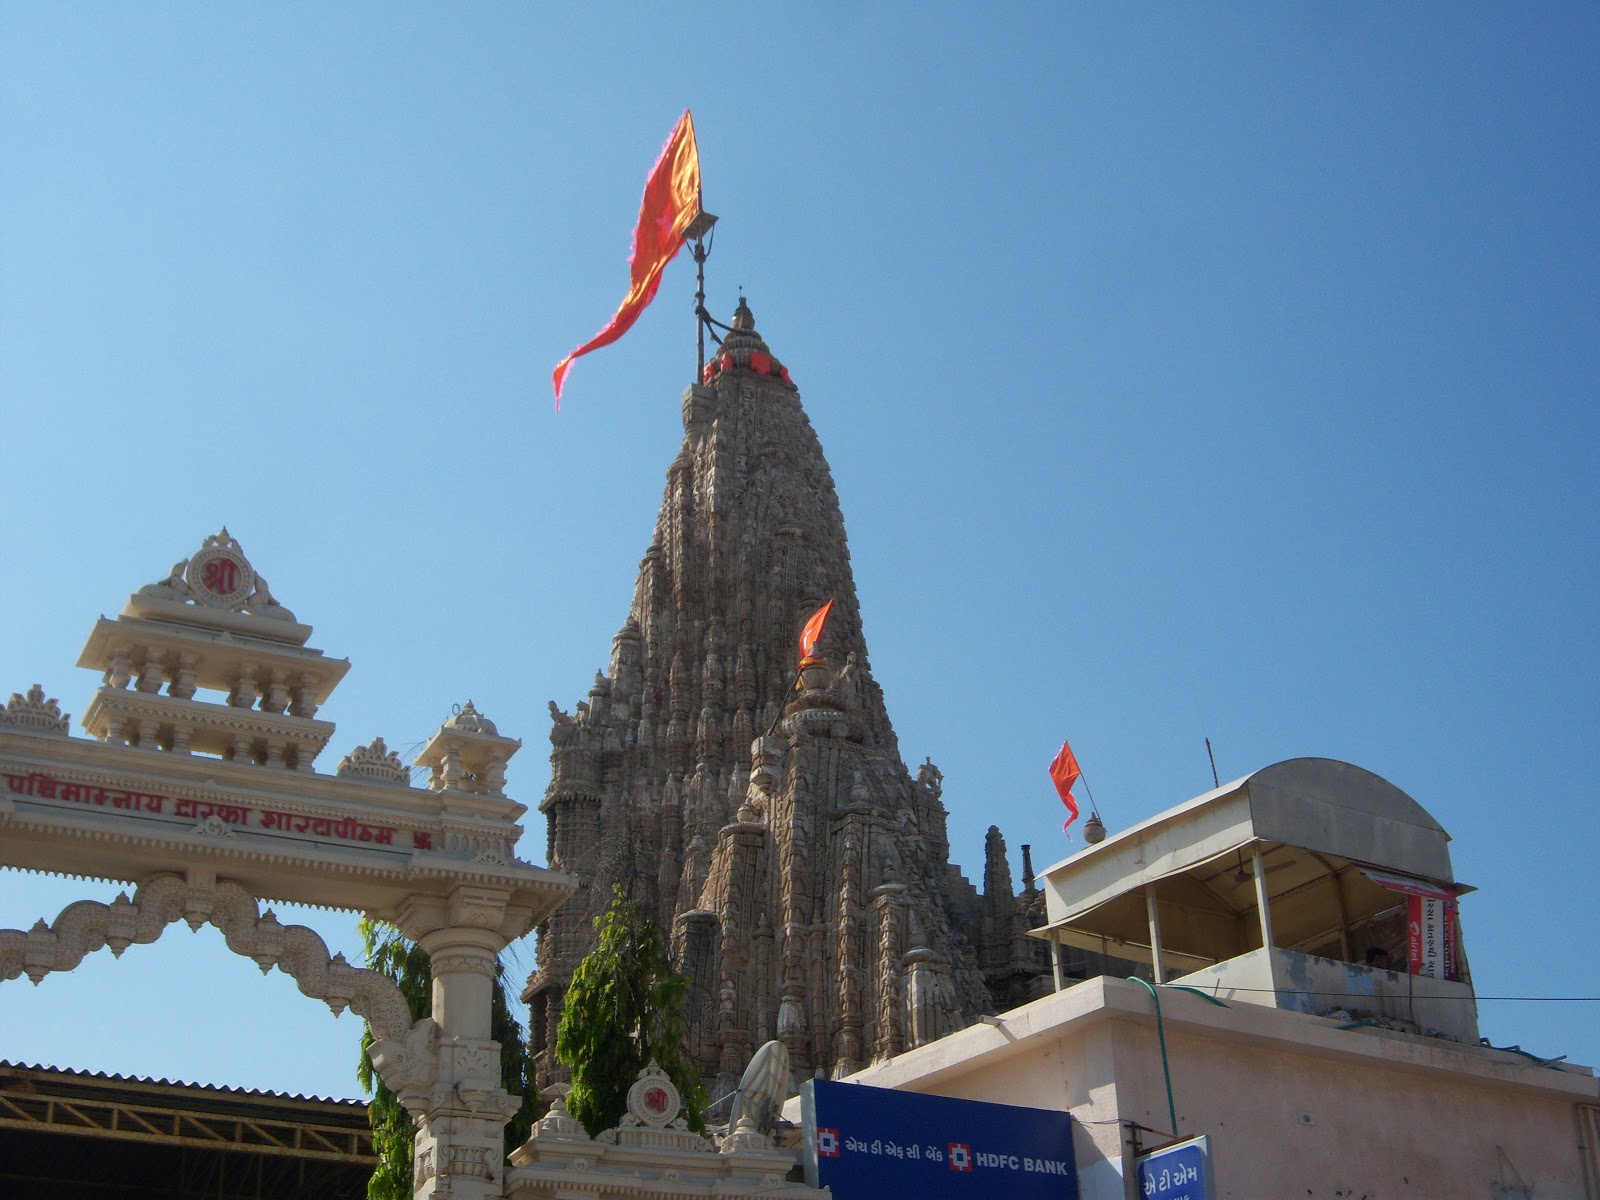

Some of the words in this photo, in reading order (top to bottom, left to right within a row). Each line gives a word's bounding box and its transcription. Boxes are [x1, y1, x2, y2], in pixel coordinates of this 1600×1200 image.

[203, 558, 239, 593] श्री
[1410, 936, 1419, 961] airtel
[845, 1136, 868, 1153] એચ
[870, 1139, 882, 1155] ડી
[884, 1141, 904, 1159] એફ
[906, 1144, 921, 1159] સી
[976, 1152, 1020, 1170] HDFC
[1023, 1157, 1068, 1176] BANK
[1144, 1173, 1156, 1196] એ
[1158, 1168, 1171, 1192] ટી
[1173, 1162, 1198, 1186] એમ
